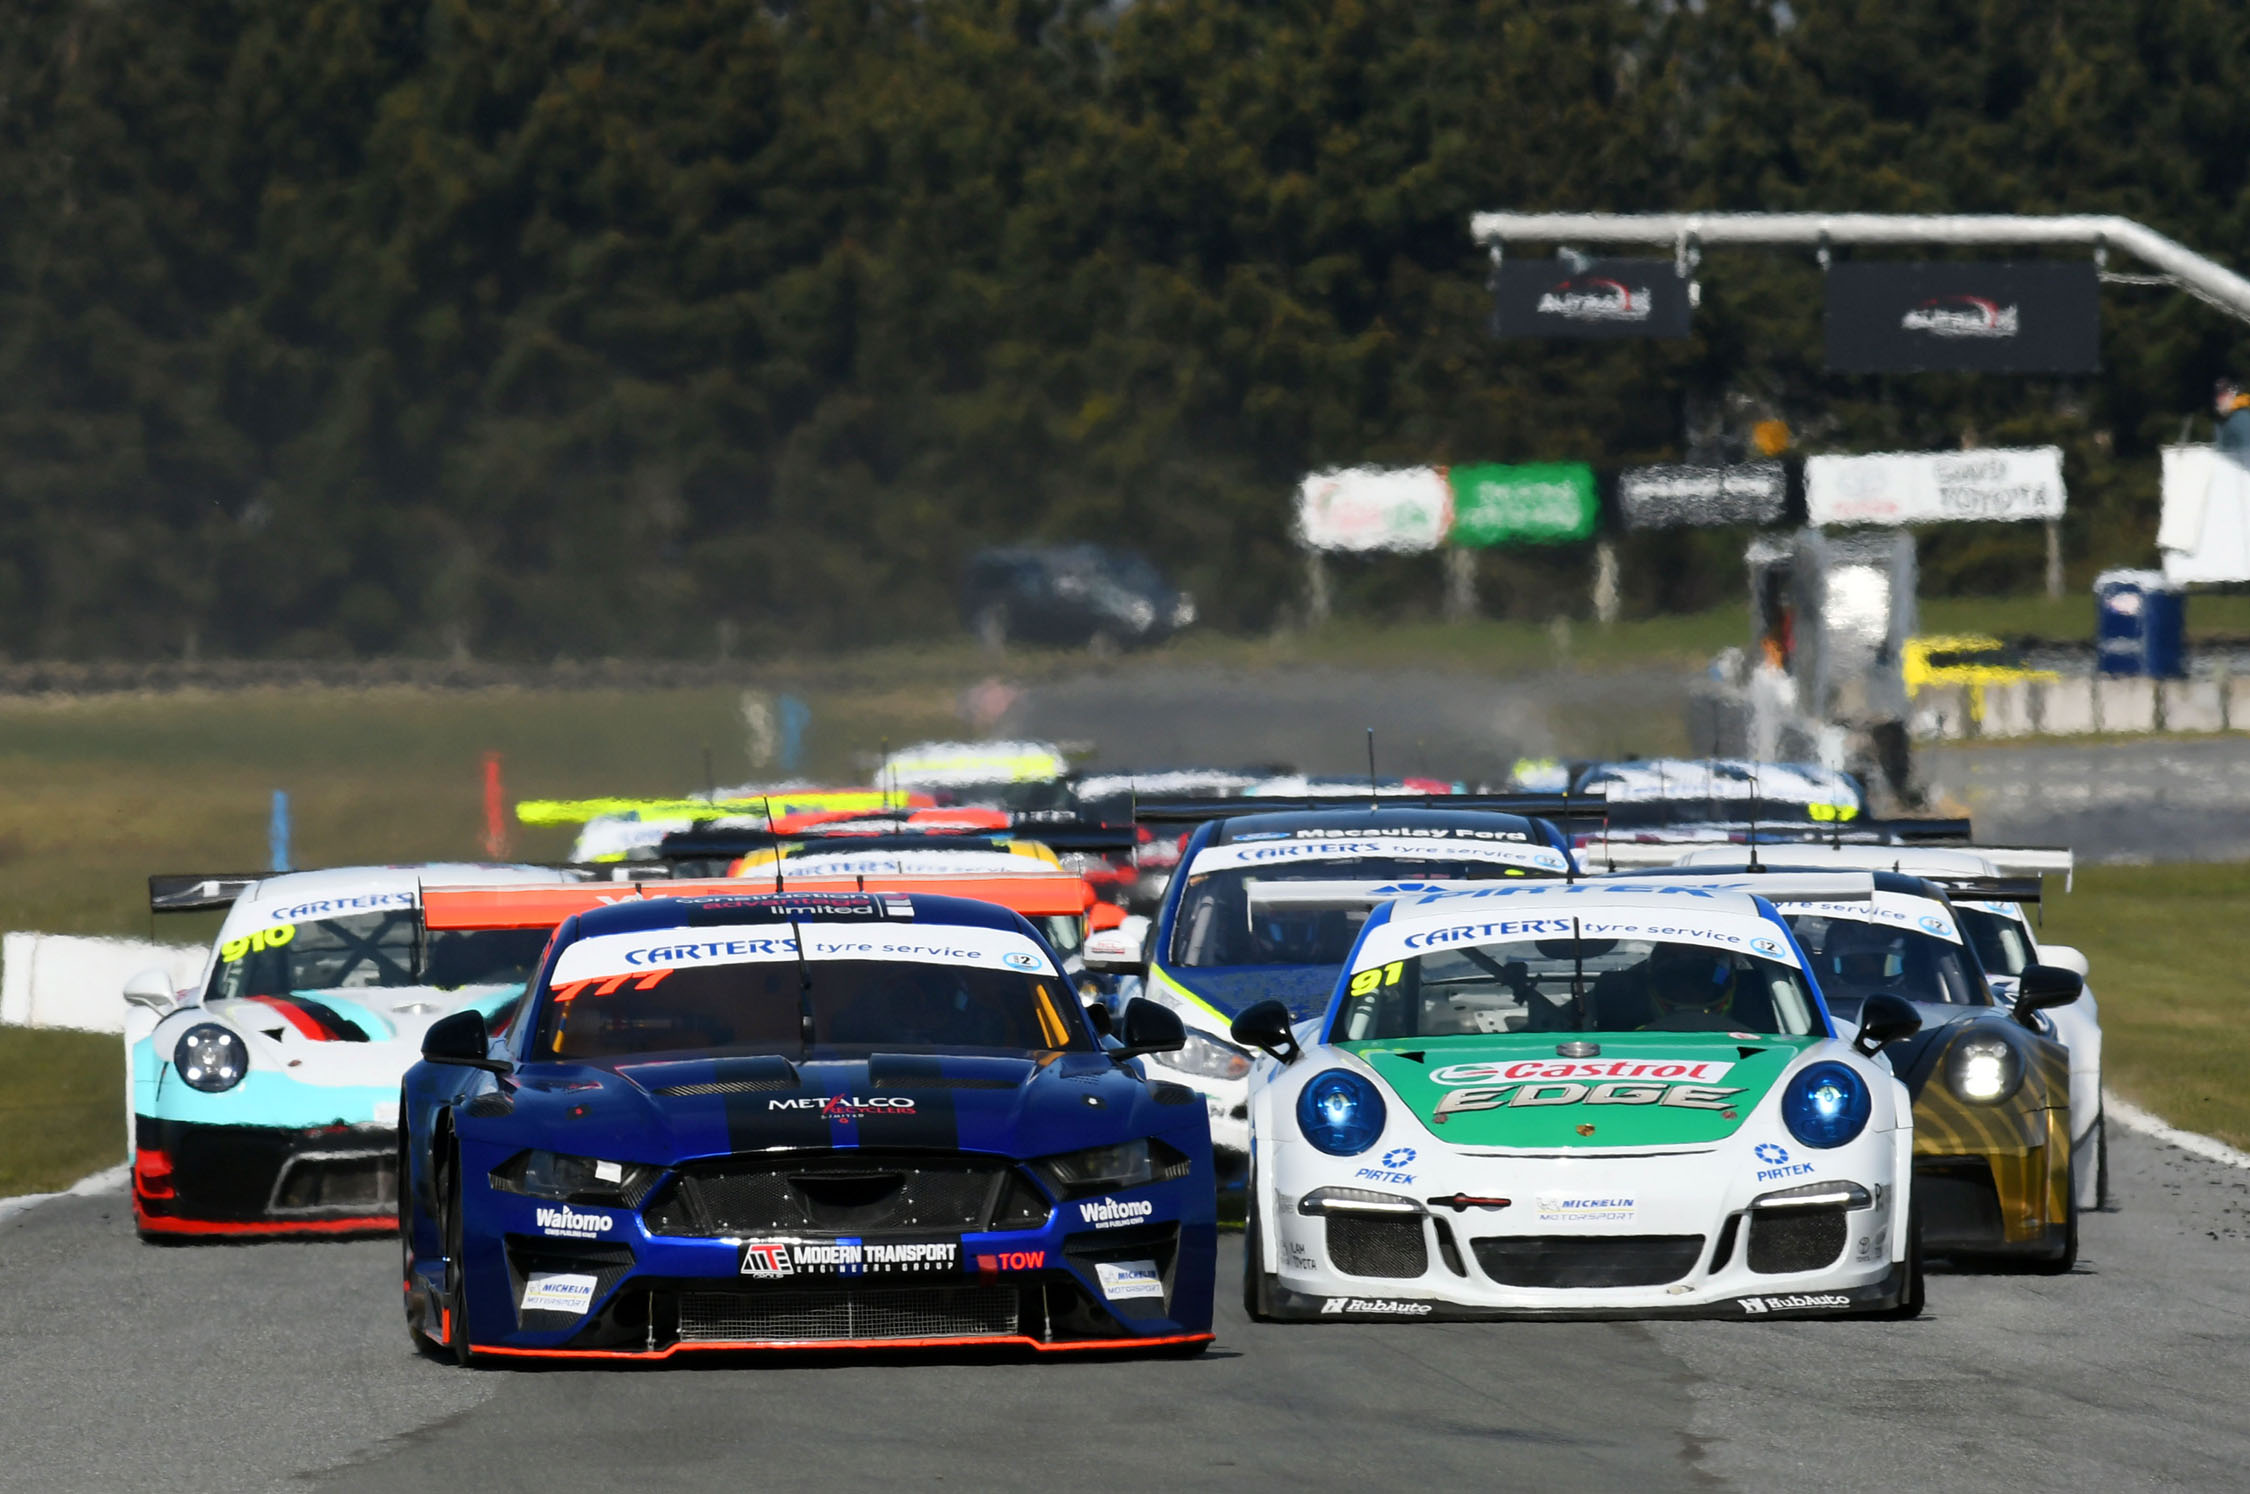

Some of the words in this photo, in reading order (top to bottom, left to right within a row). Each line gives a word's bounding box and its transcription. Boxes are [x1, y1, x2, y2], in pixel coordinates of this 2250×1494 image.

[1296, 828, 1450, 839] Macaulay
[1454, 829, 1528, 841] Ford
[1236, 842, 1380, 861] CARTER'S
[1392, 845, 1438, 855] tyre
[1446, 848, 1528, 861] service
[271, 891, 414, 919] CARTER'S
[675, 892, 870, 904] construction
[703, 898, 871, 910] advantage
[770, 905, 873, 915] limited
[220, 923, 297, 963] 910
[1403, 918, 1572, 949] CARTER'S
[1583, 922, 1638, 935] tyre
[1647, 926, 1741, 944] service
[624, 938, 801, 965] CARTER'S
[815, 942, 873, 955] tyre
[881, 943, 983, 960] service
[550, 968, 675, 1002] 777
[1349, 961, 1405, 998] 91
[1503, 1061, 1708, 1080] Castrol
[768, 1095, 916, 1111] METALCO
[1432, 1082, 1751, 1115] EDGE
[828, 1107, 917, 1115] RECYCLERS
[1354, 1168, 1417, 1185] PIRTEK
[1757, 1162, 1815, 1182] PIRTEK
[1079, 1196, 1153, 1222] Waitomo
[1561, 1199, 1635, 1209] MICHELIN
[536, 1205, 614, 1232] Waitomo
[1539, 1213, 1636, 1221] MOTORSPORT
[793, 1246, 863, 1265] MODERN
[863, 1243, 958, 1263] TRANSPORT
[997, 1250, 1046, 1271] TOW
[1117, 1270, 1157, 1280] MICHELIN
[542, 1283, 593, 1295] MICHELIN
[1346, 1299, 1433, 1313] HubAuto
[1765, 1294, 1851, 1309] HubAuto
